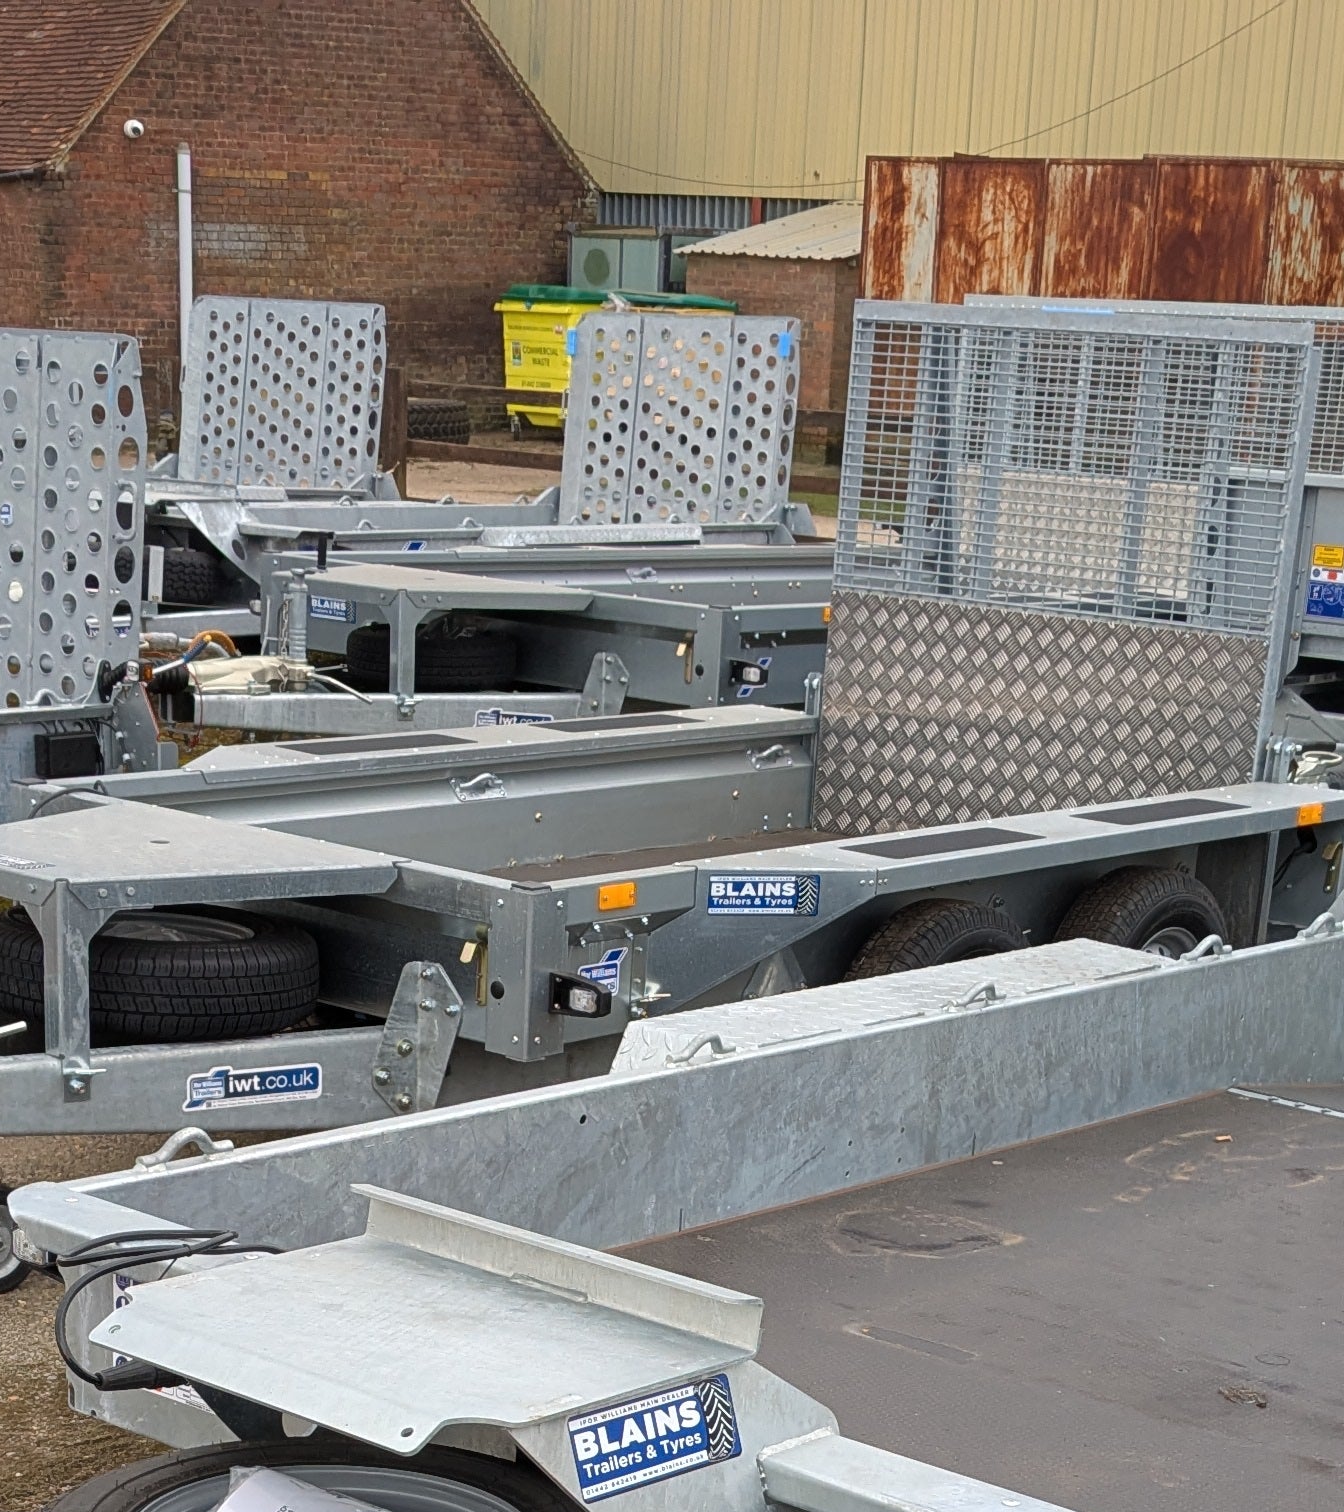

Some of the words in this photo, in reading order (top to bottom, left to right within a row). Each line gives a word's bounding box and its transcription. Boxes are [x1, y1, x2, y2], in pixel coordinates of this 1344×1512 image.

[312, 598, 346, 610] BLAINS
[710, 882, 796, 896] BLAINS
[712, 898, 752, 906] Trailers
[754, 898, 762, 906] &
[764, 898, 793, 906] Tyres
[228, 1070, 314, 1093] iwt.co.uk
[601, 1404, 638, 1420] WILLIAMS
[640, 1398, 659, 1409] MAIN
[662, 1390, 690, 1401] DEALER
[573, 1400, 701, 1462] BLAINS
[583, 1450, 643, 1478] Trailers
[646, 1444, 658, 1459] &
[660, 1432, 702, 1455] Tyres
